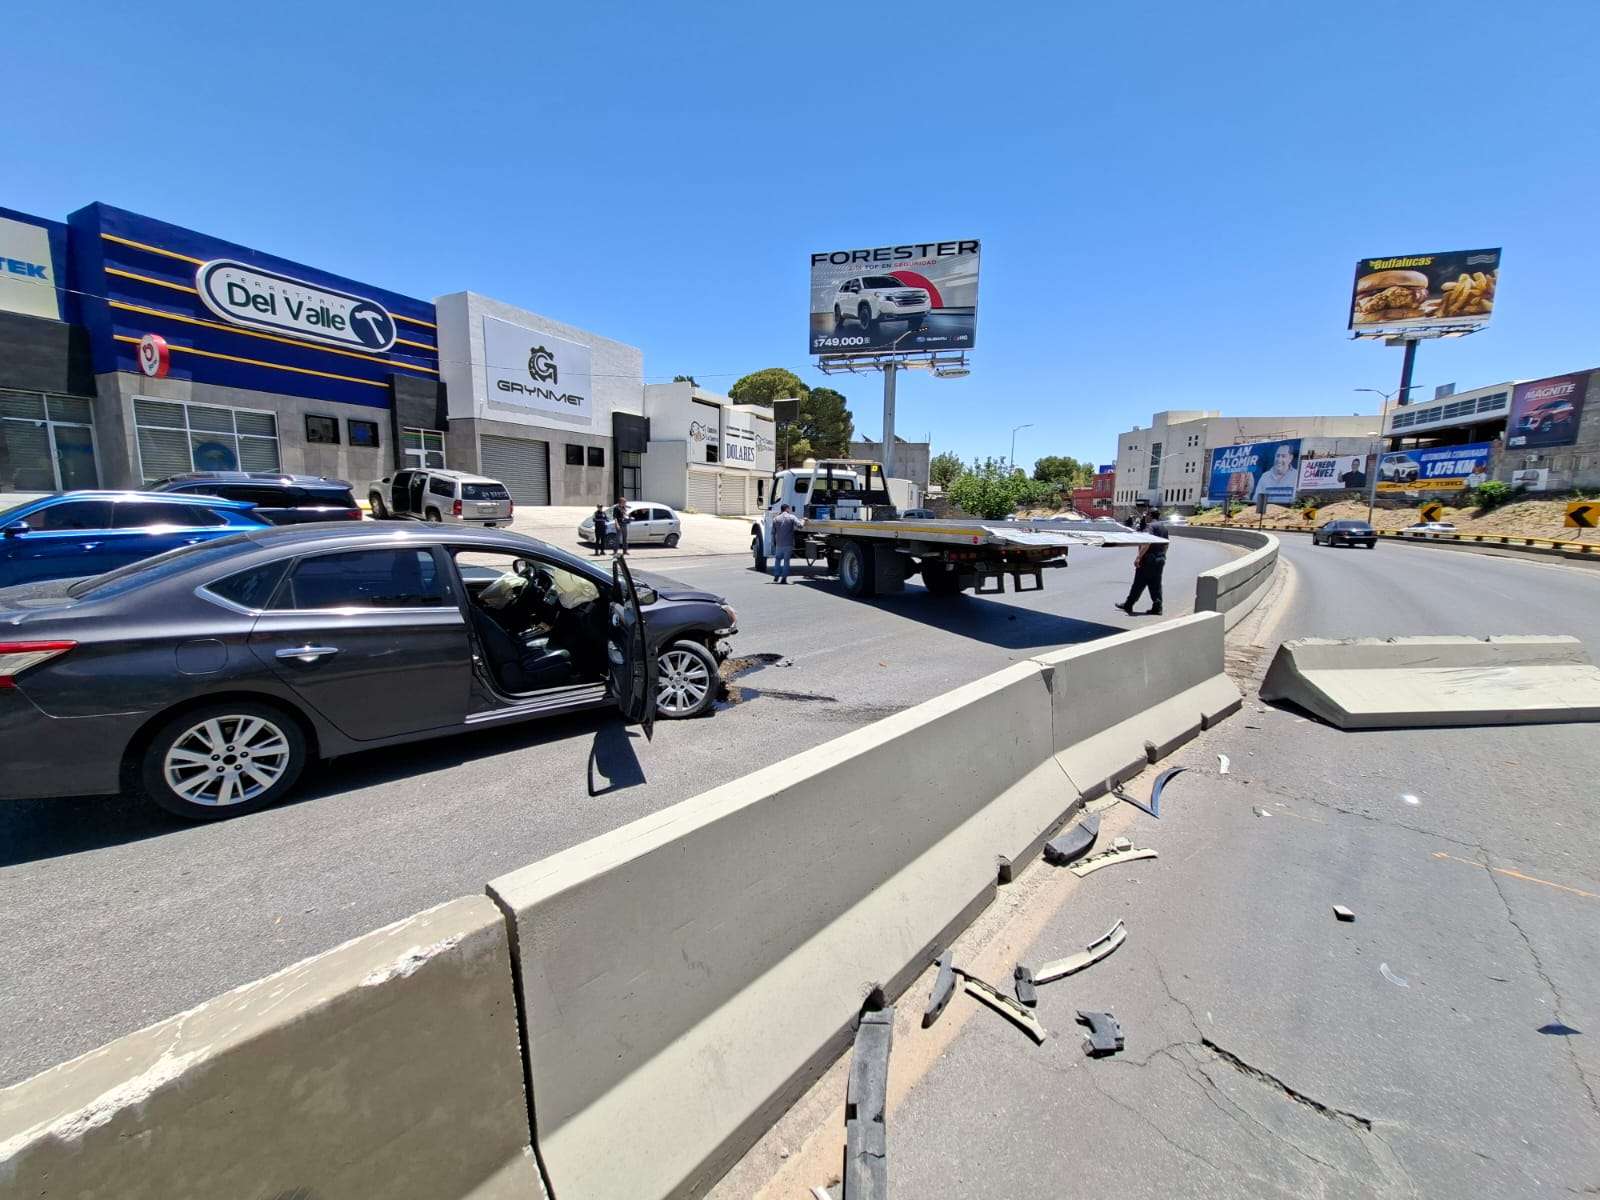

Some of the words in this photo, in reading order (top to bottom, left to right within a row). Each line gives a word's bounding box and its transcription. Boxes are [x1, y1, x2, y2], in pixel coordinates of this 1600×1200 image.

[811, 240, 979, 267] FORESTER
[227, 282, 277, 315] Del
[284, 297, 346, 331] Valle
[813, 336, 864, 347] $749,000
[496, 379, 585, 406] GRYNMET
[1524, 383, 1576, 400] MAGNITE
[726, 443, 755, 462] DOLARES
[1222, 446, 1253, 460] ALAN
[1213, 455, 1259, 470] FALOMIR
[1426, 461, 1456, 478] 1,075
